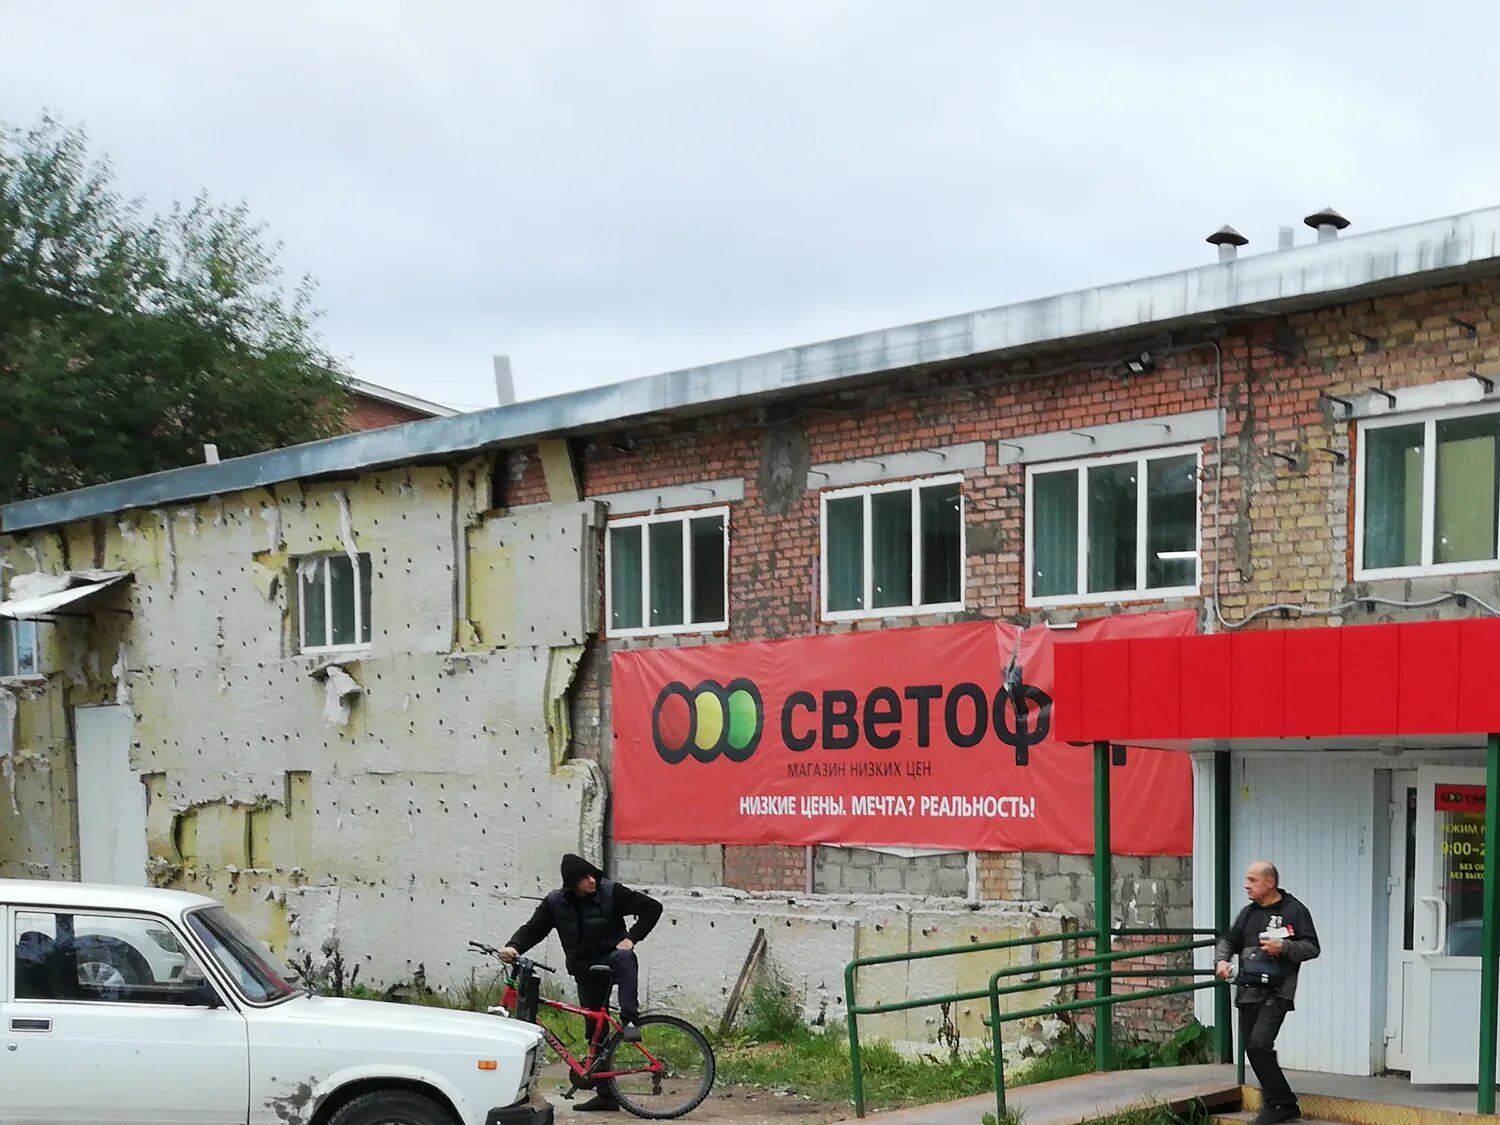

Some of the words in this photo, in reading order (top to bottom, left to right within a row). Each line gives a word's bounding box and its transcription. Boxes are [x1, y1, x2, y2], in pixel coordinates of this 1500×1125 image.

[781, 665, 1127, 767] светоф
[787, 762, 846, 778] МАГАЗИН
[850, 761, 901, 777] НИЗКИХ
[906, 761, 932, 779] ЦЕН
[739, 796, 796, 816] НИЗКИЕ
[800, 796, 847, 818] ЦЕНЫ.
[851, 796, 915, 817] МЕЧТА?
[920, 796, 1036, 818] РЕАЛЬНОСТЬ!
